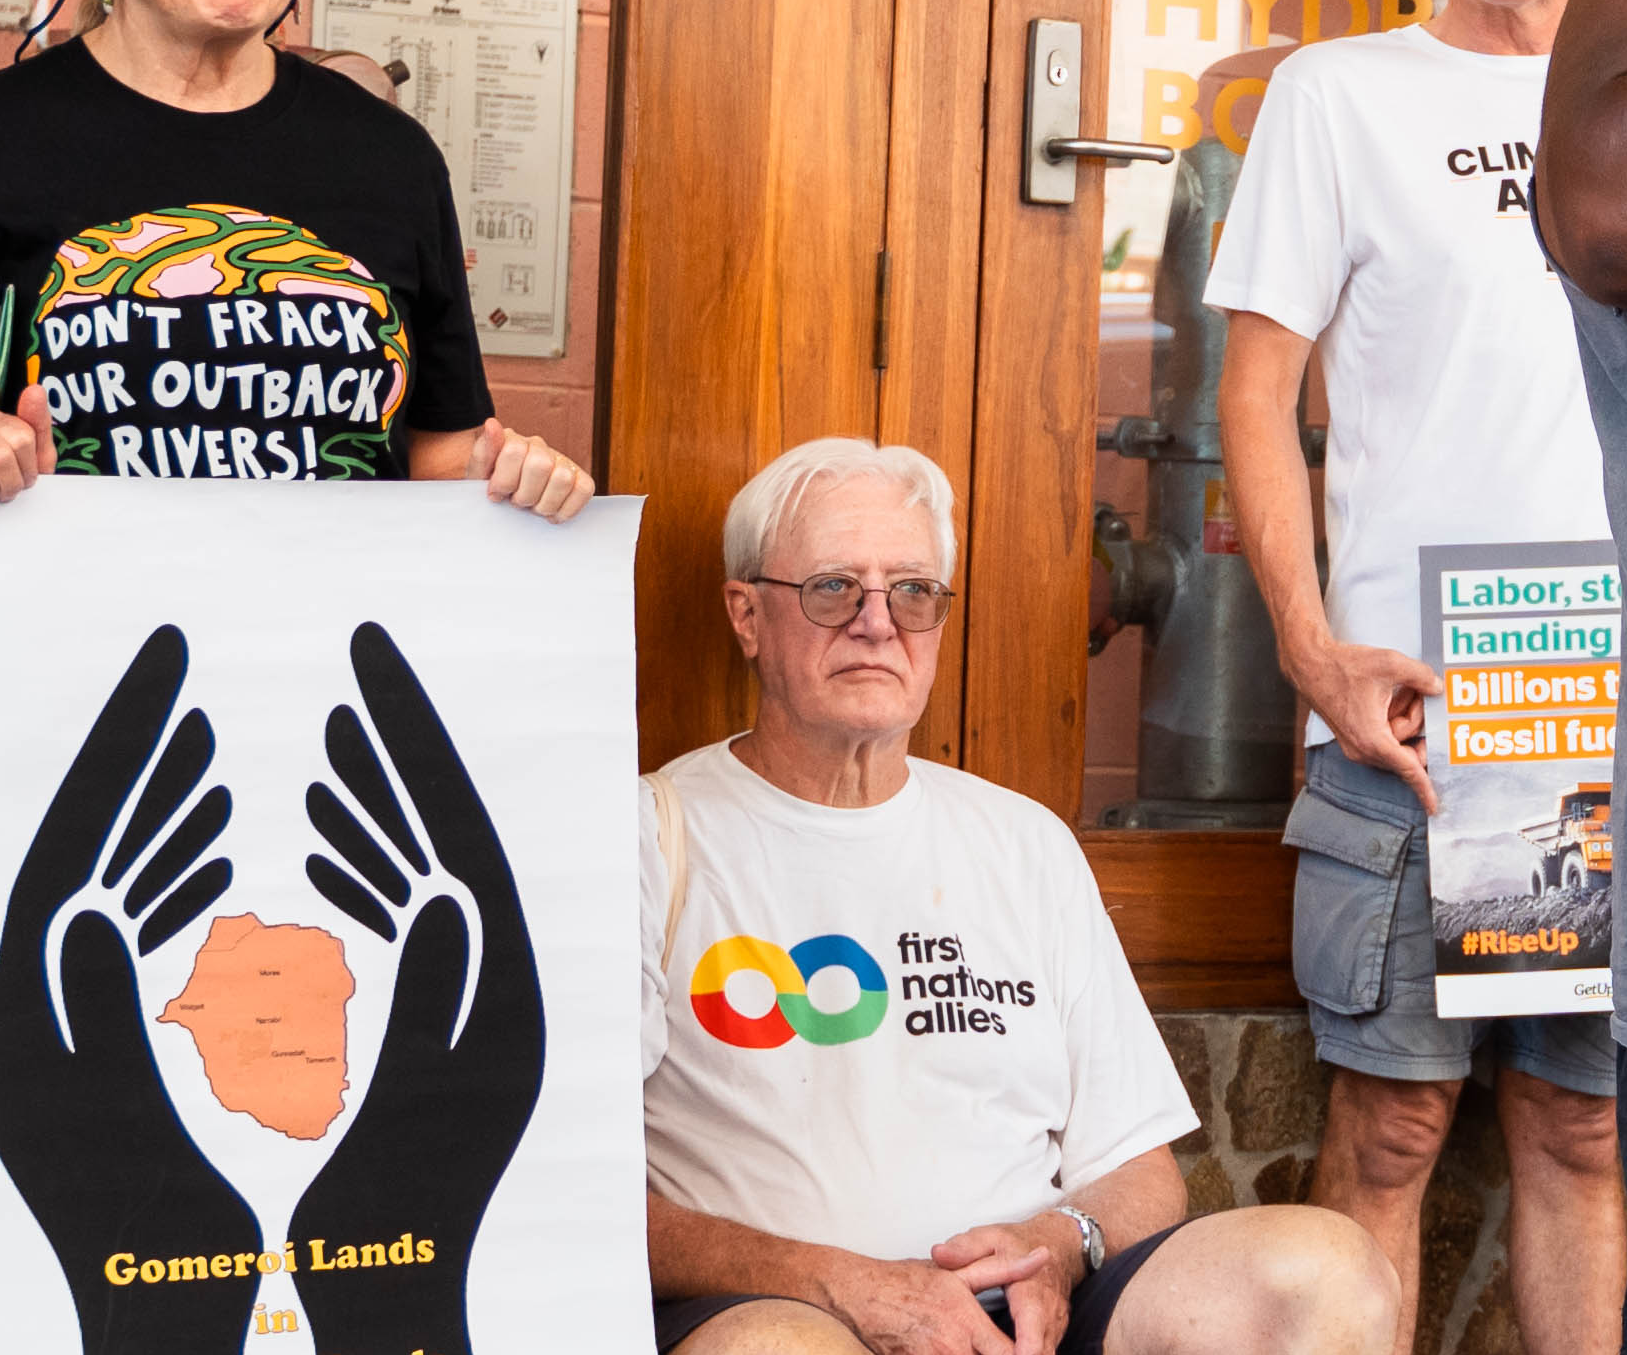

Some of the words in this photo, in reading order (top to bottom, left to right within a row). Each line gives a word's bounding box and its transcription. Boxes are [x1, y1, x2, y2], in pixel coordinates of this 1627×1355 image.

[207, 299, 376, 355] FRACK
[42, 361, 136, 424] OUR
[151, 360, 384, 423] OUTBACK
[109, 424, 318, 481] RIVERS!
[1450, 574, 1572, 609] Labor,
[1451, 621, 1612, 658] handing
[1452, 670, 1596, 707] billions
[1454, 720, 1557, 757] fossil
[897, 932, 965, 965] first
[1462, 927, 1579, 955] #RiseUp
[902, 965, 1035, 1007] nations
[906, 1002, 1006, 1036] allies
[104, 1242, 298, 1285] Gomeroi
[309, 1233, 435, 1271] Lands
[254, 1303, 299, 1335] in
